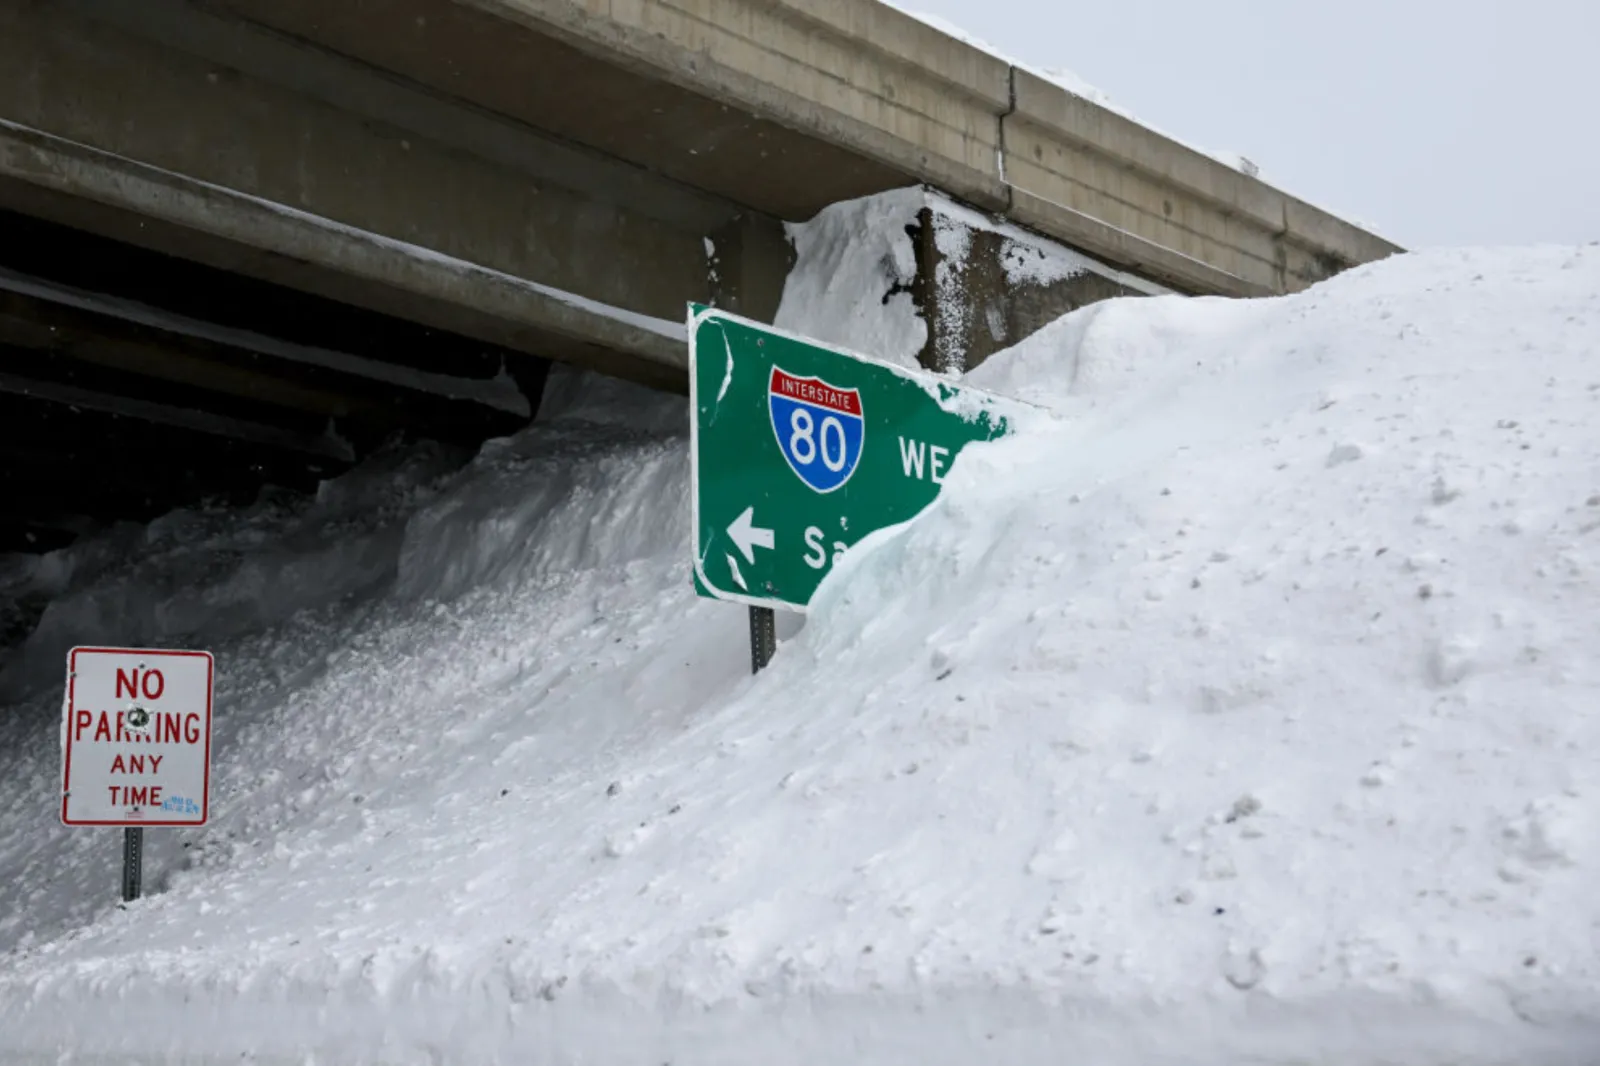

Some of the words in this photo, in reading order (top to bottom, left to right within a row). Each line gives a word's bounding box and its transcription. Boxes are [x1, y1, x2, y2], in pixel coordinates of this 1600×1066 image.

[782, 379, 851, 409] INTERSTATE
[790, 408, 846, 472] 80
[898, 436, 949, 484] WE
[116, 669, 164, 699] NO
[76, 711, 200, 744] PARING
[110, 755, 163, 774] ANY
[109, 786, 162, 806] TIME
